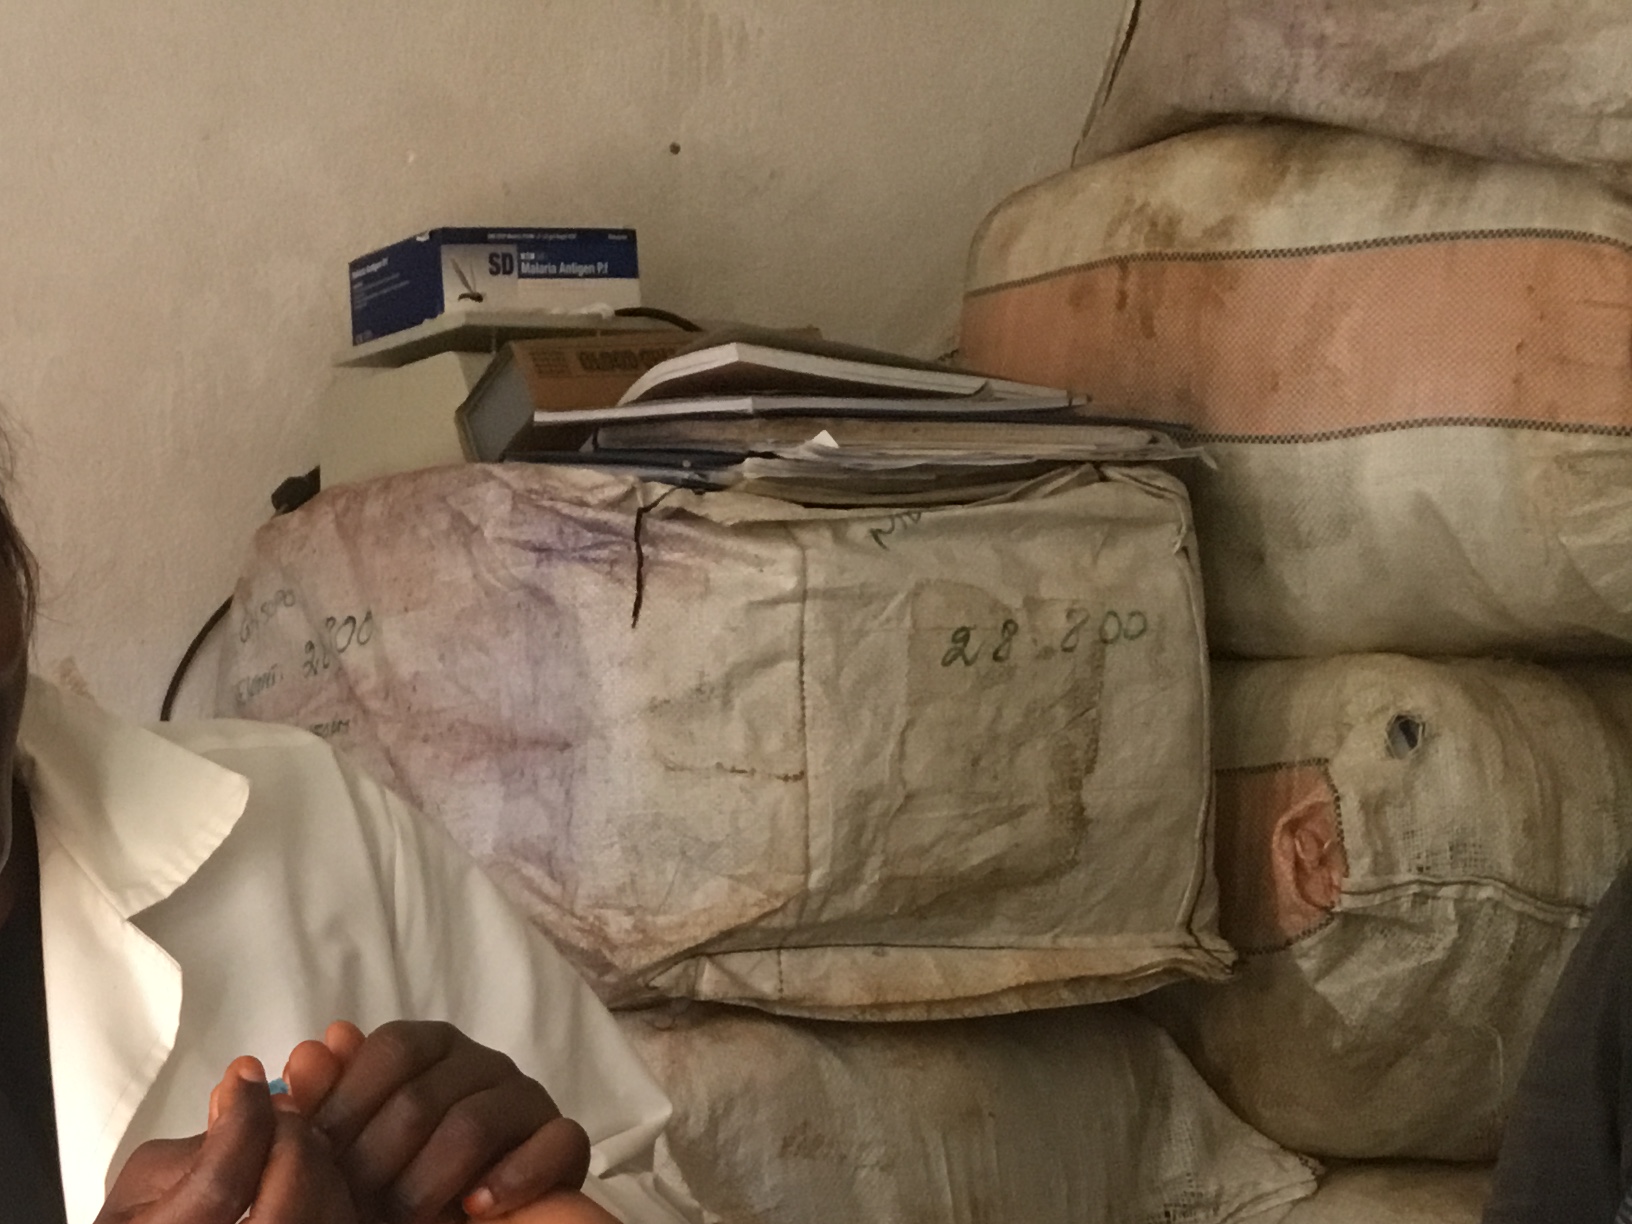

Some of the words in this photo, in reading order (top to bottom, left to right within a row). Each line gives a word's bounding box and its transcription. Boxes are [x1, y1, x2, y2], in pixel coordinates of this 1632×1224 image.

[488, 252, 514, 276] SD
[520, 262, 557, 274] Malaria
[559, 262, 595, 276] Antigen
